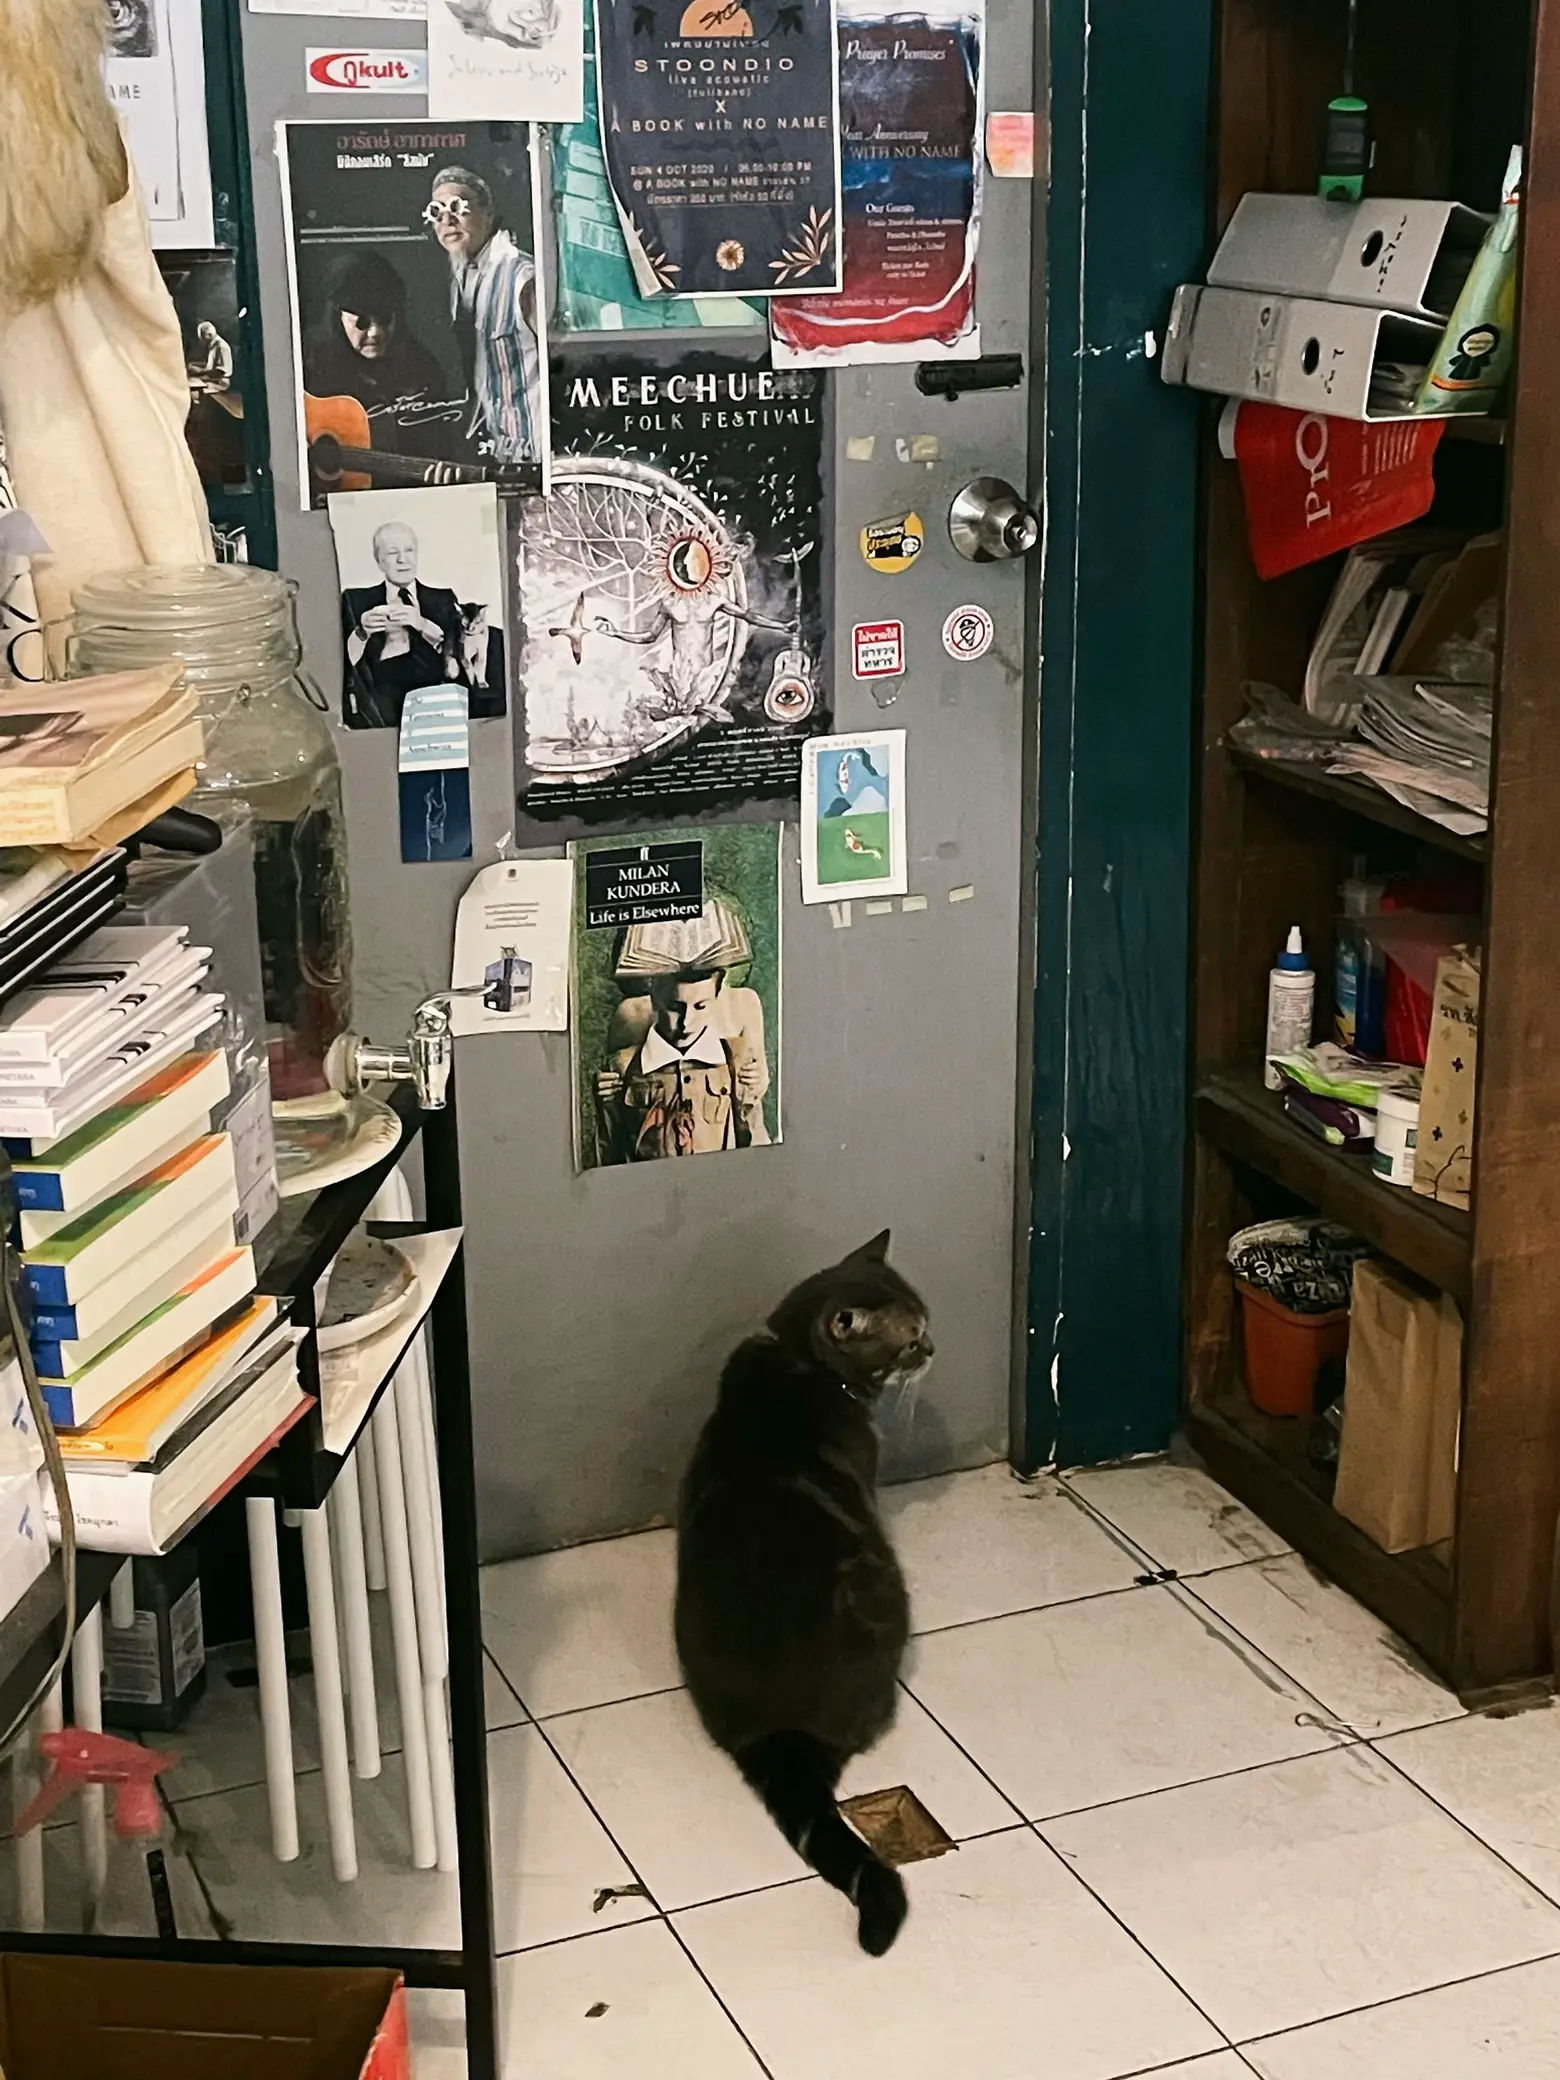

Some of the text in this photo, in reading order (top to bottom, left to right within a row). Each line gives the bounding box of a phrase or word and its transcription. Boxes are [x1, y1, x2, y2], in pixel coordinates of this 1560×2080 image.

[634, 57, 794, 73] STOONDIO
[668, 74, 770, 85] live acoustic
[610, 115, 828, 133] A BOOK with NO NAME
[850, 144, 961, 160] WITH NO NAME
[666, 164, 687, 175] OCT
[656, 178, 685, 189] BOOK
[624, 407, 816, 432] FOLK FESTIVAL
[618, 863, 670, 882] MILAN
[607, 881, 681, 901] KUNDERA
[590, 902, 701, 926] Life is Elsewhere
